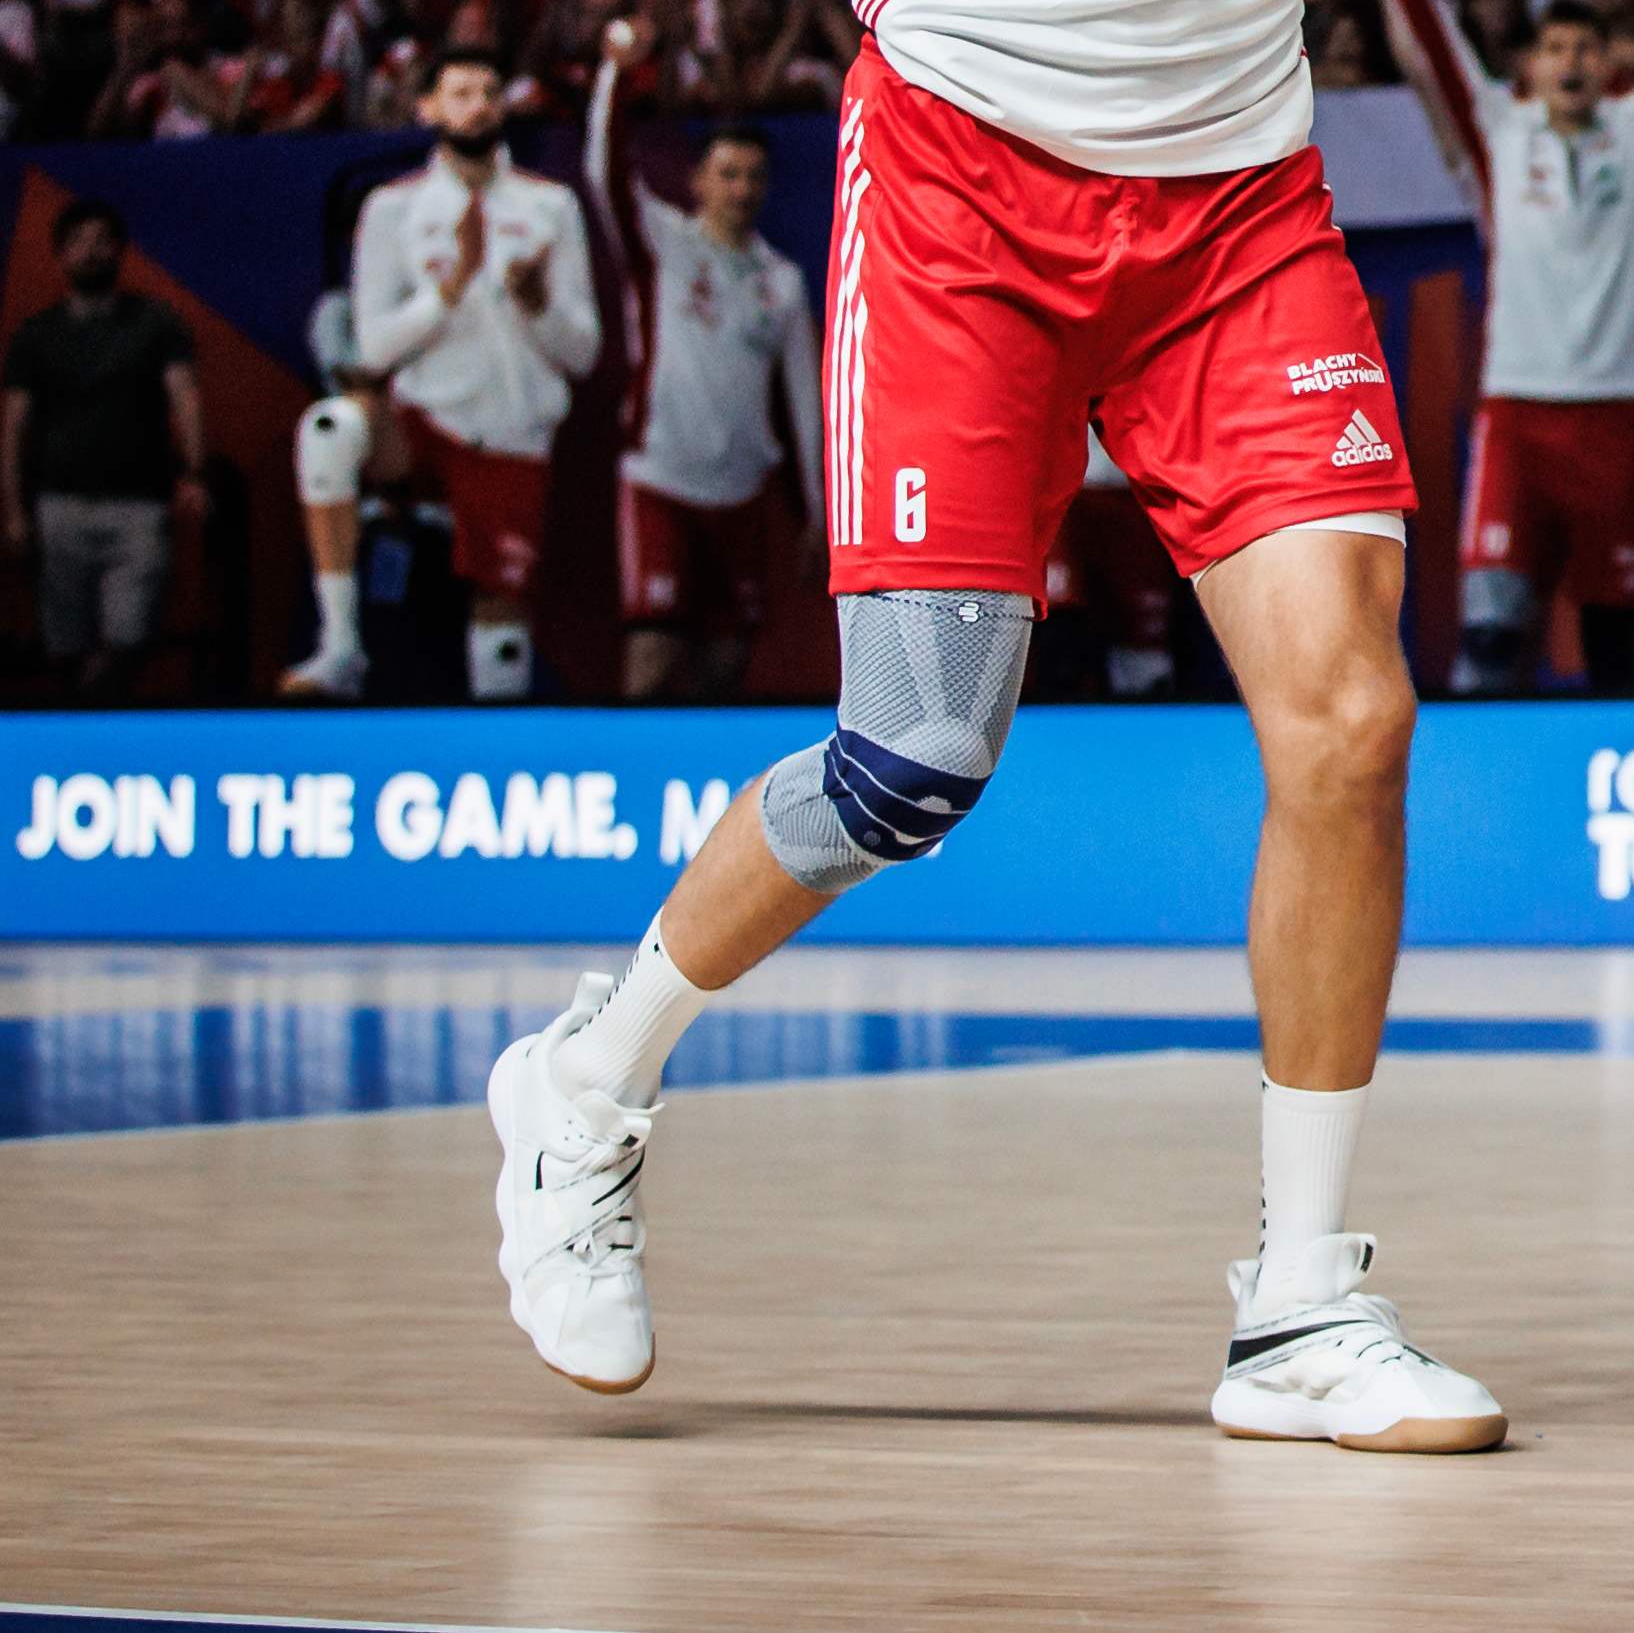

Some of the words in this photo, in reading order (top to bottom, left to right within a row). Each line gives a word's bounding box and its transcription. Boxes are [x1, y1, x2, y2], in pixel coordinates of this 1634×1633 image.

[1286, 353, 1357, 381] BLACHY
[1330, 443, 1393, 468] adidas
[894, 466, 927, 543] 6
[16, 773, 196, 860] JOIN
[217, 773, 355, 859] THE
[376, 771, 639, 861] GAME.
